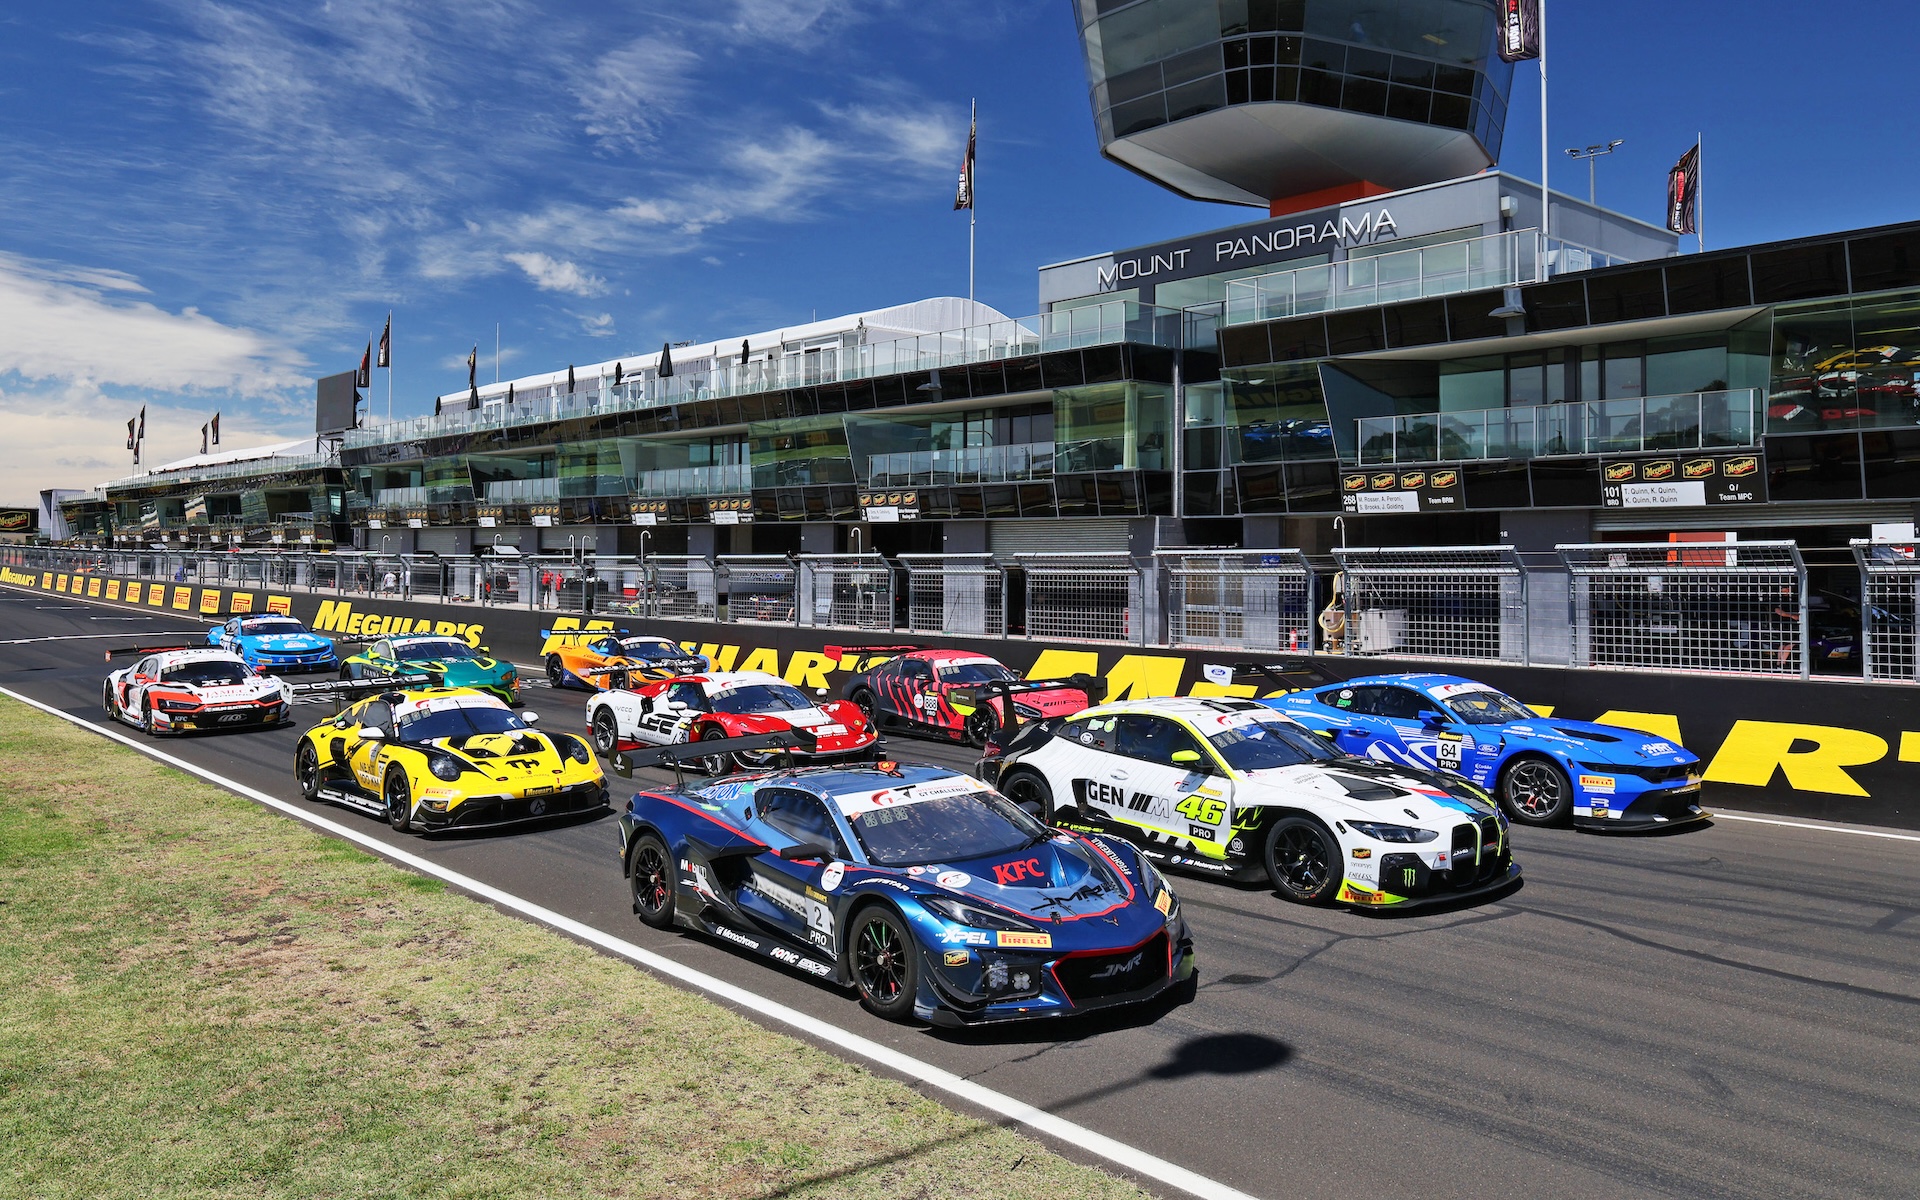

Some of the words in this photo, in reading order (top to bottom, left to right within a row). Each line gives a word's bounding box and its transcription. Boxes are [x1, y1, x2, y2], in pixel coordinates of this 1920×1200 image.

[1097, 248, 1191, 285] MOUNT
[1215, 208, 1398, 262] PANORAMA
[1604, 487, 1620, 498] 101
[1631, 488, 1650, 496] Quinn,
[1658, 487, 1678, 495] Quinn,
[1719, 493, 1737, 501] Team
[1343, 495, 1357, 505] 268
[1428, 497, 1442, 505] Team
[1632, 496, 1651, 504] Quinn,
[1660, 495, 1677, 503] Quinn
[232, 598, 250, 613] PIRELLI
[292, 674, 430, 690] PORSCHE
[1502, 729, 1536, 738] FORD
[1537, 734, 1585, 747] RACING
[1441, 743, 1457, 759] 64
[1440, 760, 1458, 769] PRO
[1582, 777, 1614, 785] PIRELLI
[929, 787, 970, 797] CHALLENGE
[1088, 780, 1124, 808] GEN
[1174, 793, 1227, 826] 46
[1192, 827, 1212, 839] PRO
[992, 858, 1045, 885] KFC
[814, 905, 824, 928] 2
[723, 928, 760, 950] Monochrome
[809, 930, 828, 946] PRO
[941, 928, 991, 945] XPEL
[1001, 933, 1048, 945] PIRELLI
[1089, 952, 1143, 979] JMR
